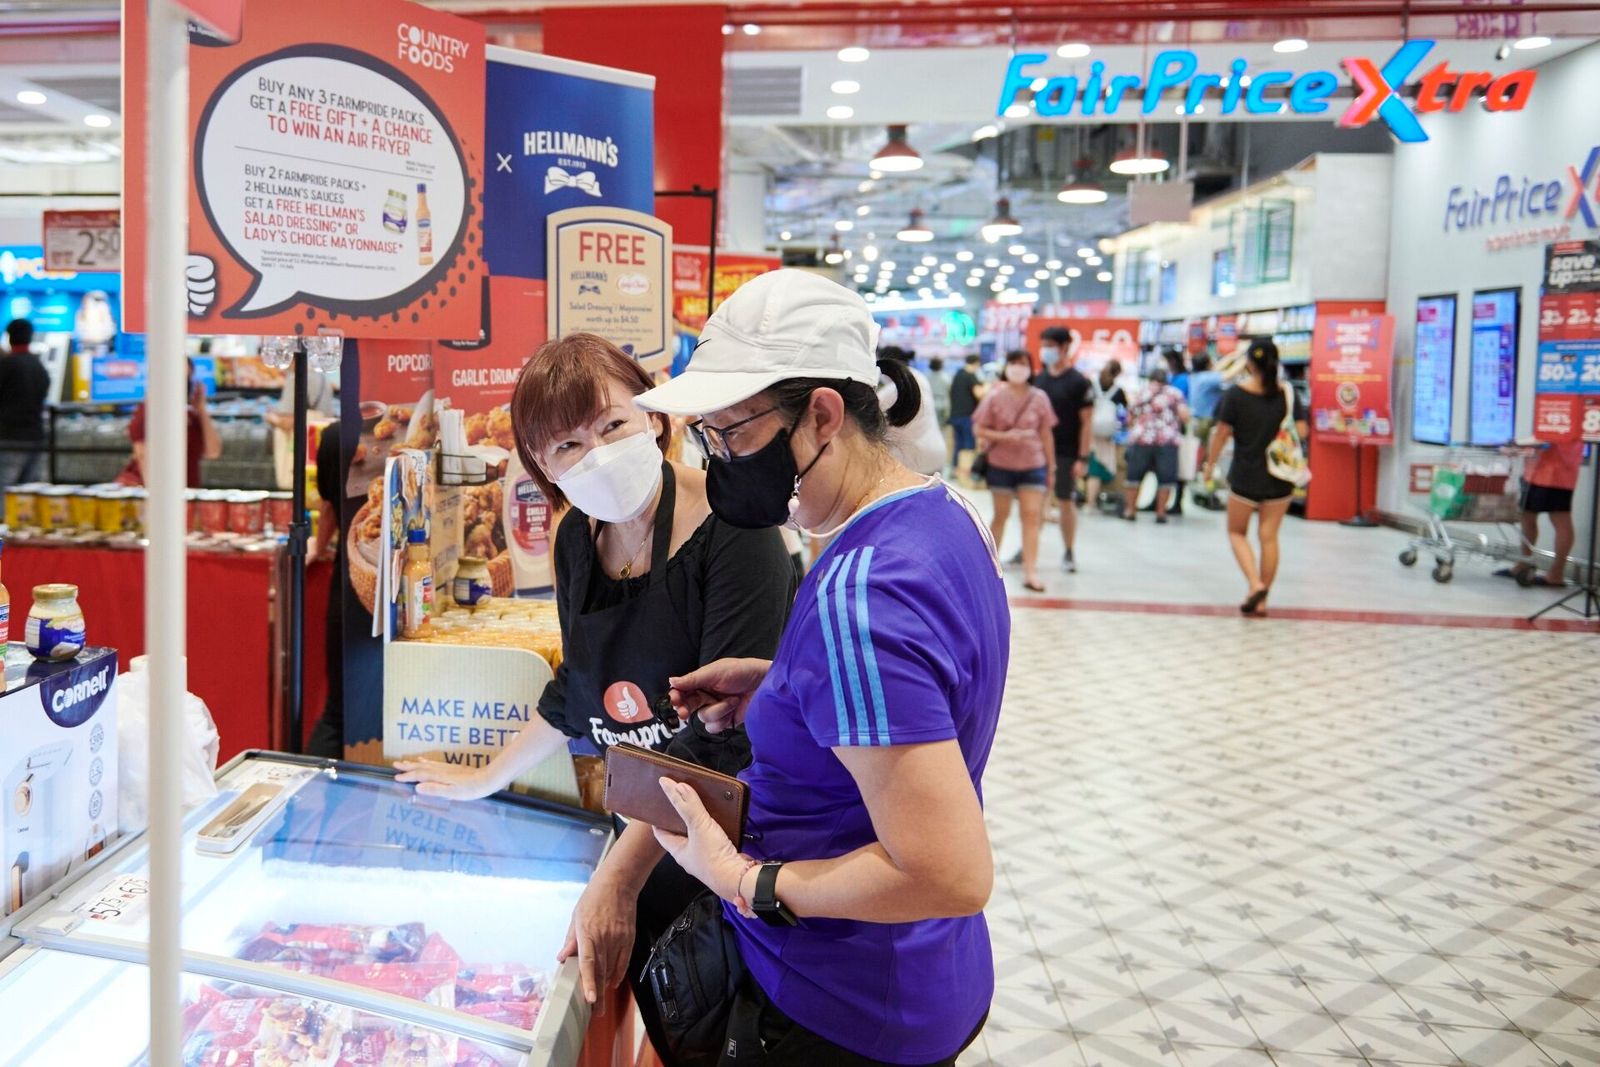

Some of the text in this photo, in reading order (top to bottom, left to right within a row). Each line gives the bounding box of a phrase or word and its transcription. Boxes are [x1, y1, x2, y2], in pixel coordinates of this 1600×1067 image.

[397, 23, 470, 59] COUNTRY
[398, 41, 454, 73] FOODS
[258, 76, 425, 127] BUY ANY 3 FARMPRIDE PACKS
[996, 39, 1538, 142] FairPrice Xtra
[250, 94, 275, 111] GET
[278, 100, 287, 115] A
[290, 99, 323, 122] FREE
[326, 108, 357, 128] GIFT
[371, 118, 381, 134] A
[384, 120, 433, 145] CHANCE
[267, 114, 411, 156] TO WIN AN AIR FRYER
[523, 131, 618, 168] HELLMANN'S
[244, 164, 265, 178] BUY
[268, 166, 277, 180] 2
[279, 169, 328, 188] FARMPRIDE
[331, 177, 360, 192] PACKS
[245, 180, 345, 205] 2 HELLMAN'S SAUCES
[245, 196, 366, 222] GET A FREE HELLMAN'S
[1444, 175, 1562, 233] FairPrice
[245, 210, 284, 227] SALAD
[345, 222, 359, 236] OR
[245, 226, 287, 243] LADY'S
[290, 231, 328, 248] CHOICE
[579, 231, 646, 266] FREE
[1551, 254, 1596, 272] save
[452, 369, 488, 388] GARLIC
[401, 698, 465, 719] MAKE
[397, 723, 461, 744] TASTE
[589, 717, 688, 750] Farmpri
[444, 751, 490, 769] WIT
